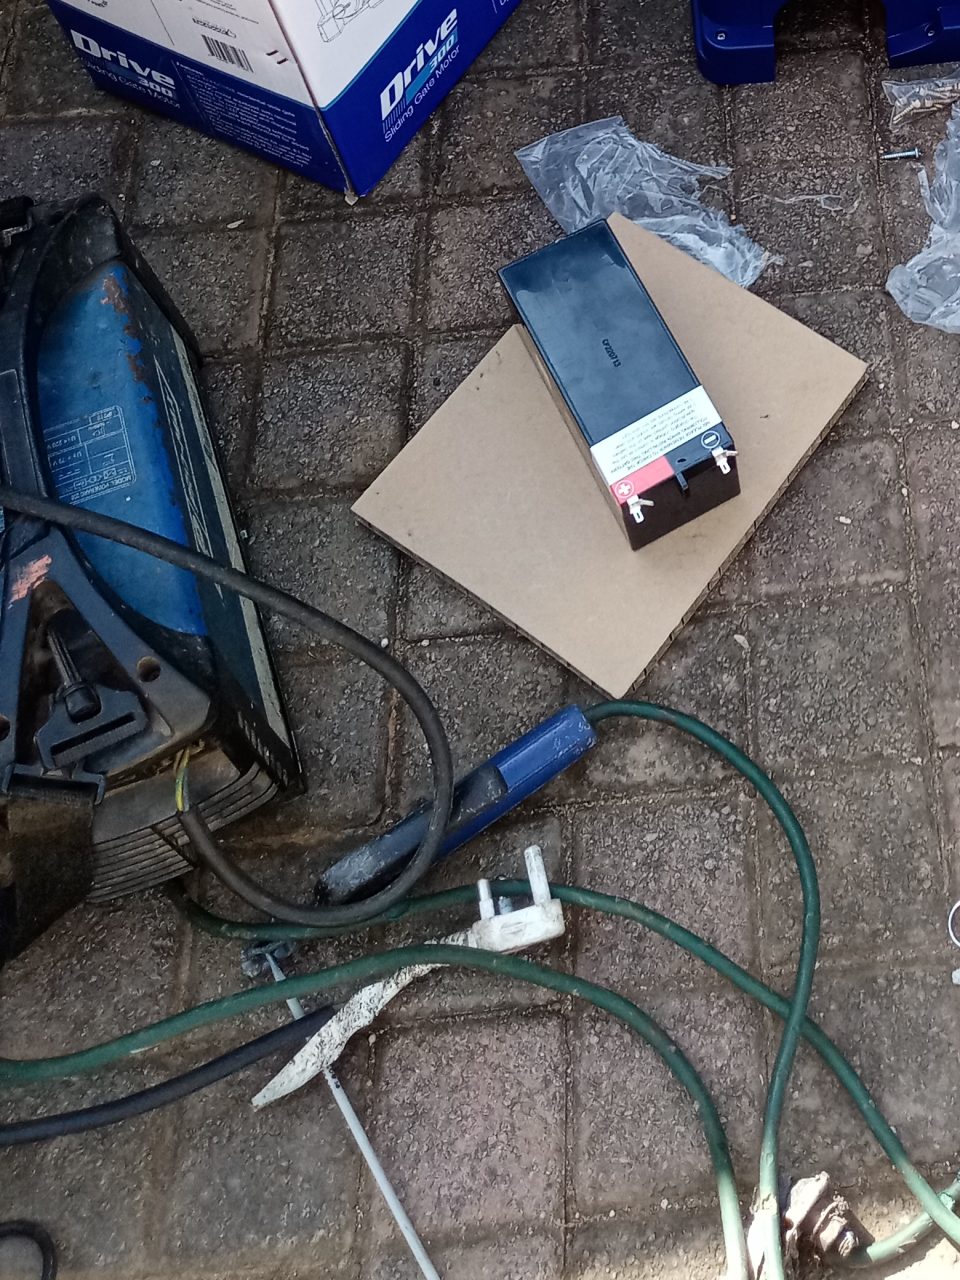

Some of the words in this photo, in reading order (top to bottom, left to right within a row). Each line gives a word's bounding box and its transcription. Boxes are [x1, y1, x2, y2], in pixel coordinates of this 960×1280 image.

[70, 29, 176, 89] Drive
[374, 5, 460, 122] Drive
[427, 31, 458, 73] 300
[137, 76, 173, 98] 300
[383, 103, 414, 145] Sliding
[413, 75, 436, 106] Gate
[434, 43, 461, 79] Motor
